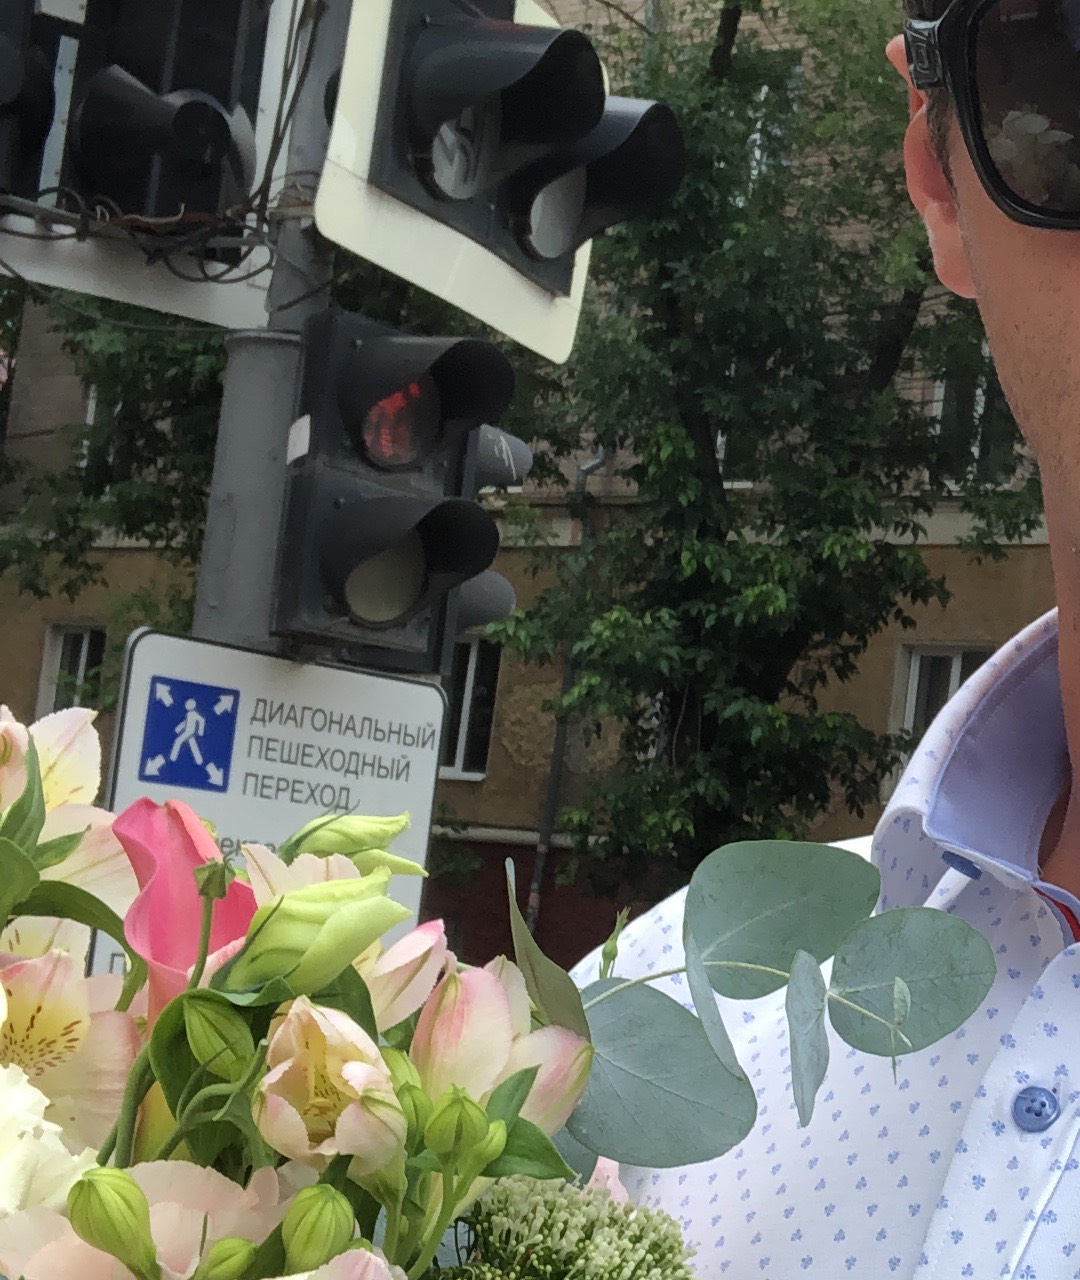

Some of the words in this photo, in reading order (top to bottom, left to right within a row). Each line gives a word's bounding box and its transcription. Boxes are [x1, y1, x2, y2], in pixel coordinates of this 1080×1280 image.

[250, 697, 436, 751] ДИАГОНАЛЬНЫЙ
[247, 735, 411, 783] ПЕШЕХОДНЫЙ
[242, 772, 351, 812] ПЕРЕХОД
